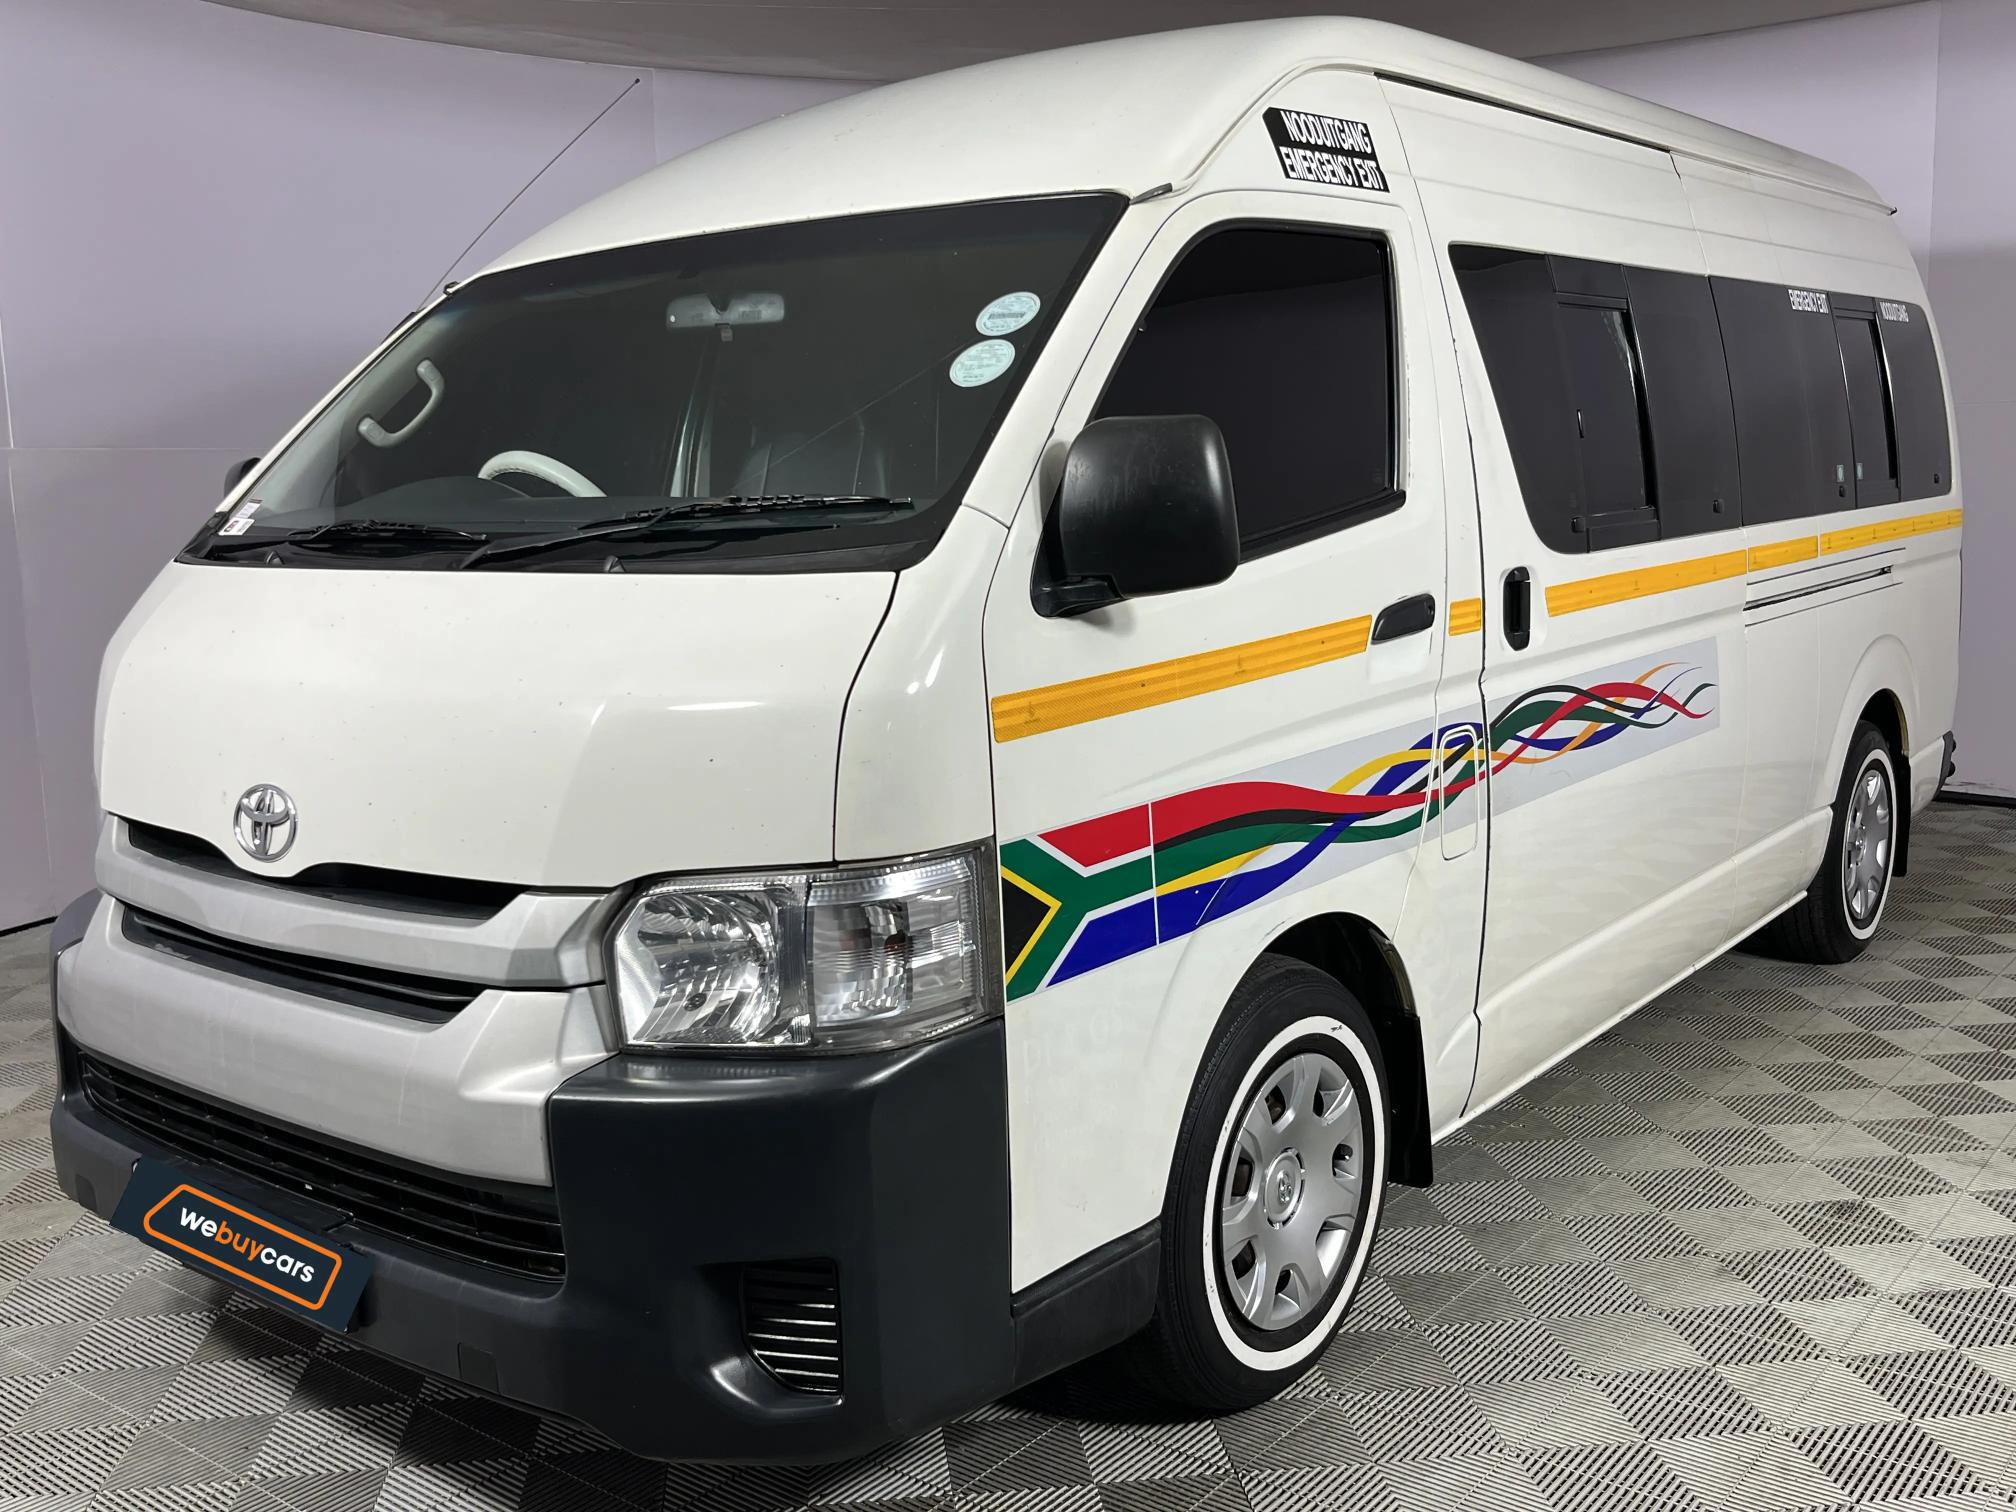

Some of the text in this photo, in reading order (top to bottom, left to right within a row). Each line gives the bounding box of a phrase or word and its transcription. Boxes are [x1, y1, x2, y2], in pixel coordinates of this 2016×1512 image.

[1280, 110, 1372, 154] NOODUITGANG
[1279, 146, 1384, 190] EMERGENCY EXIT
[180, 1207, 315, 1283] webuycars
